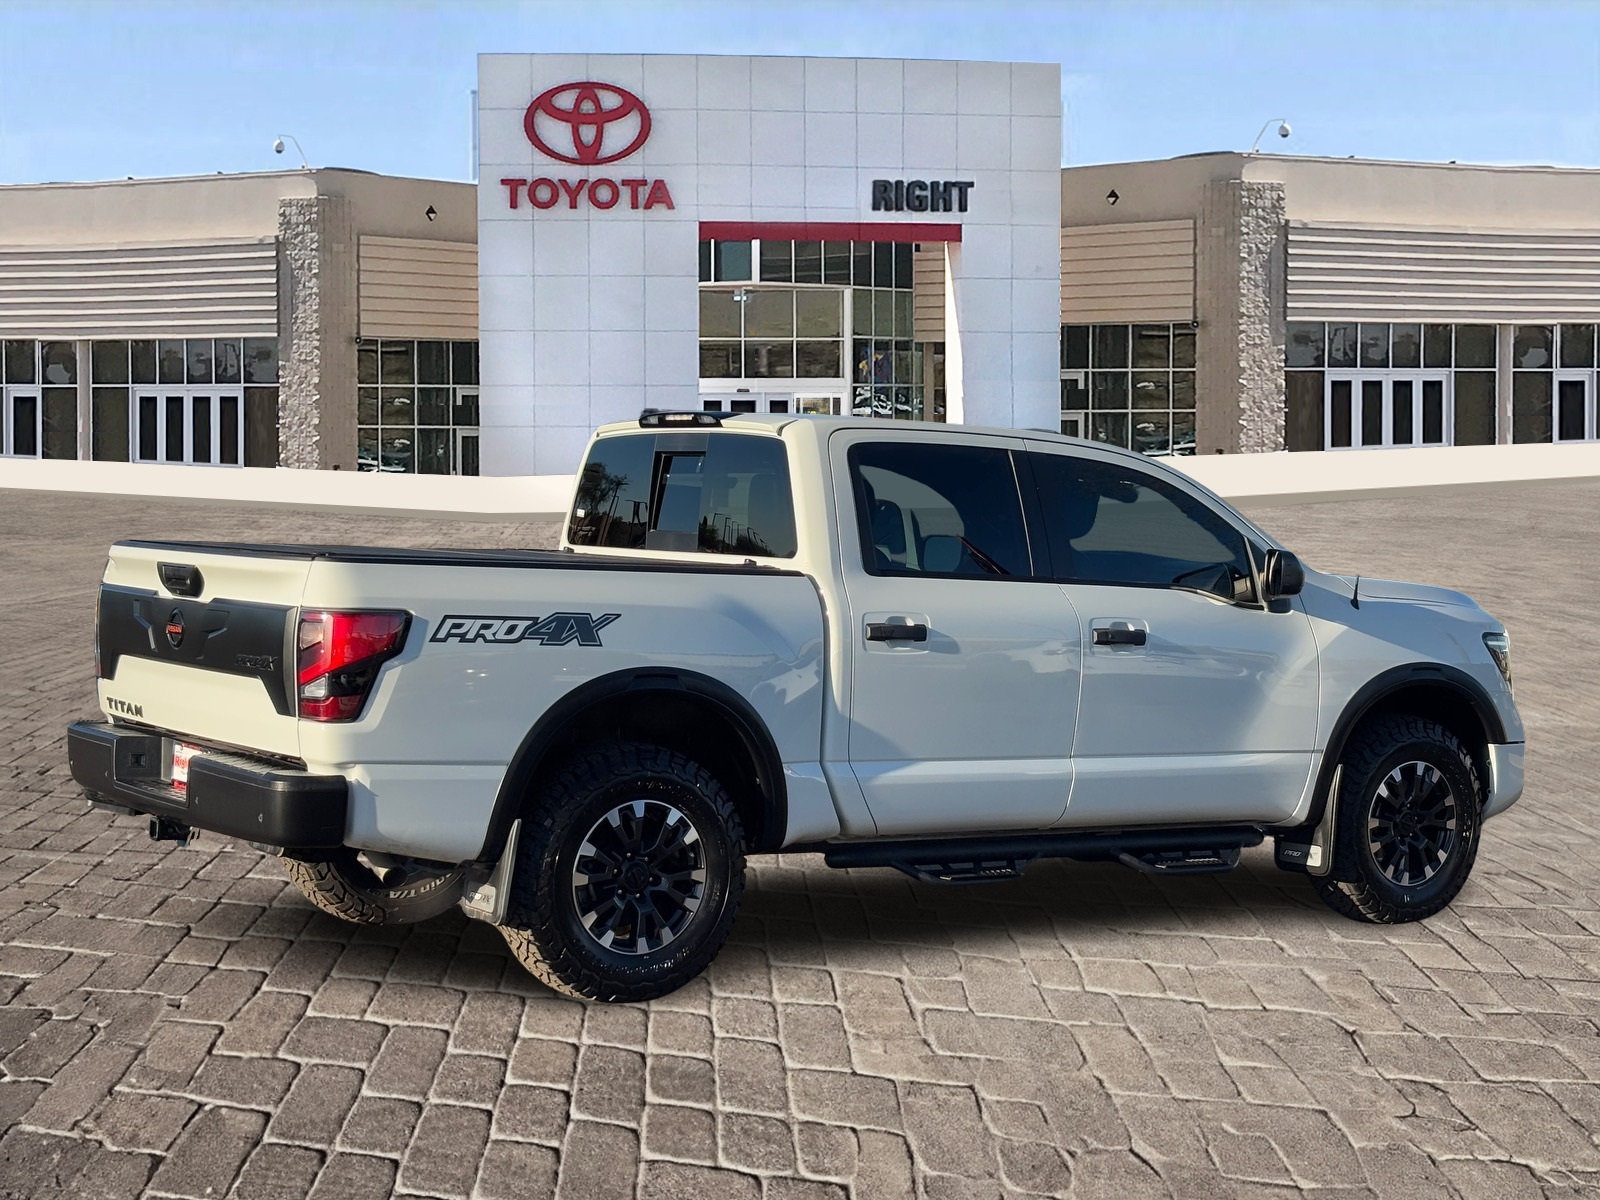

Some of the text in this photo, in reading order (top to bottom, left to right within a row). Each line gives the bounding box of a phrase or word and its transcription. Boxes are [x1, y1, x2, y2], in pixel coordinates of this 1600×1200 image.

[501, 178, 675, 210] TOYOTA
[872, 180, 975, 213] RIGHT
[106, 696, 144, 718] TITAN
[389, 889, 418, 899] T/A
